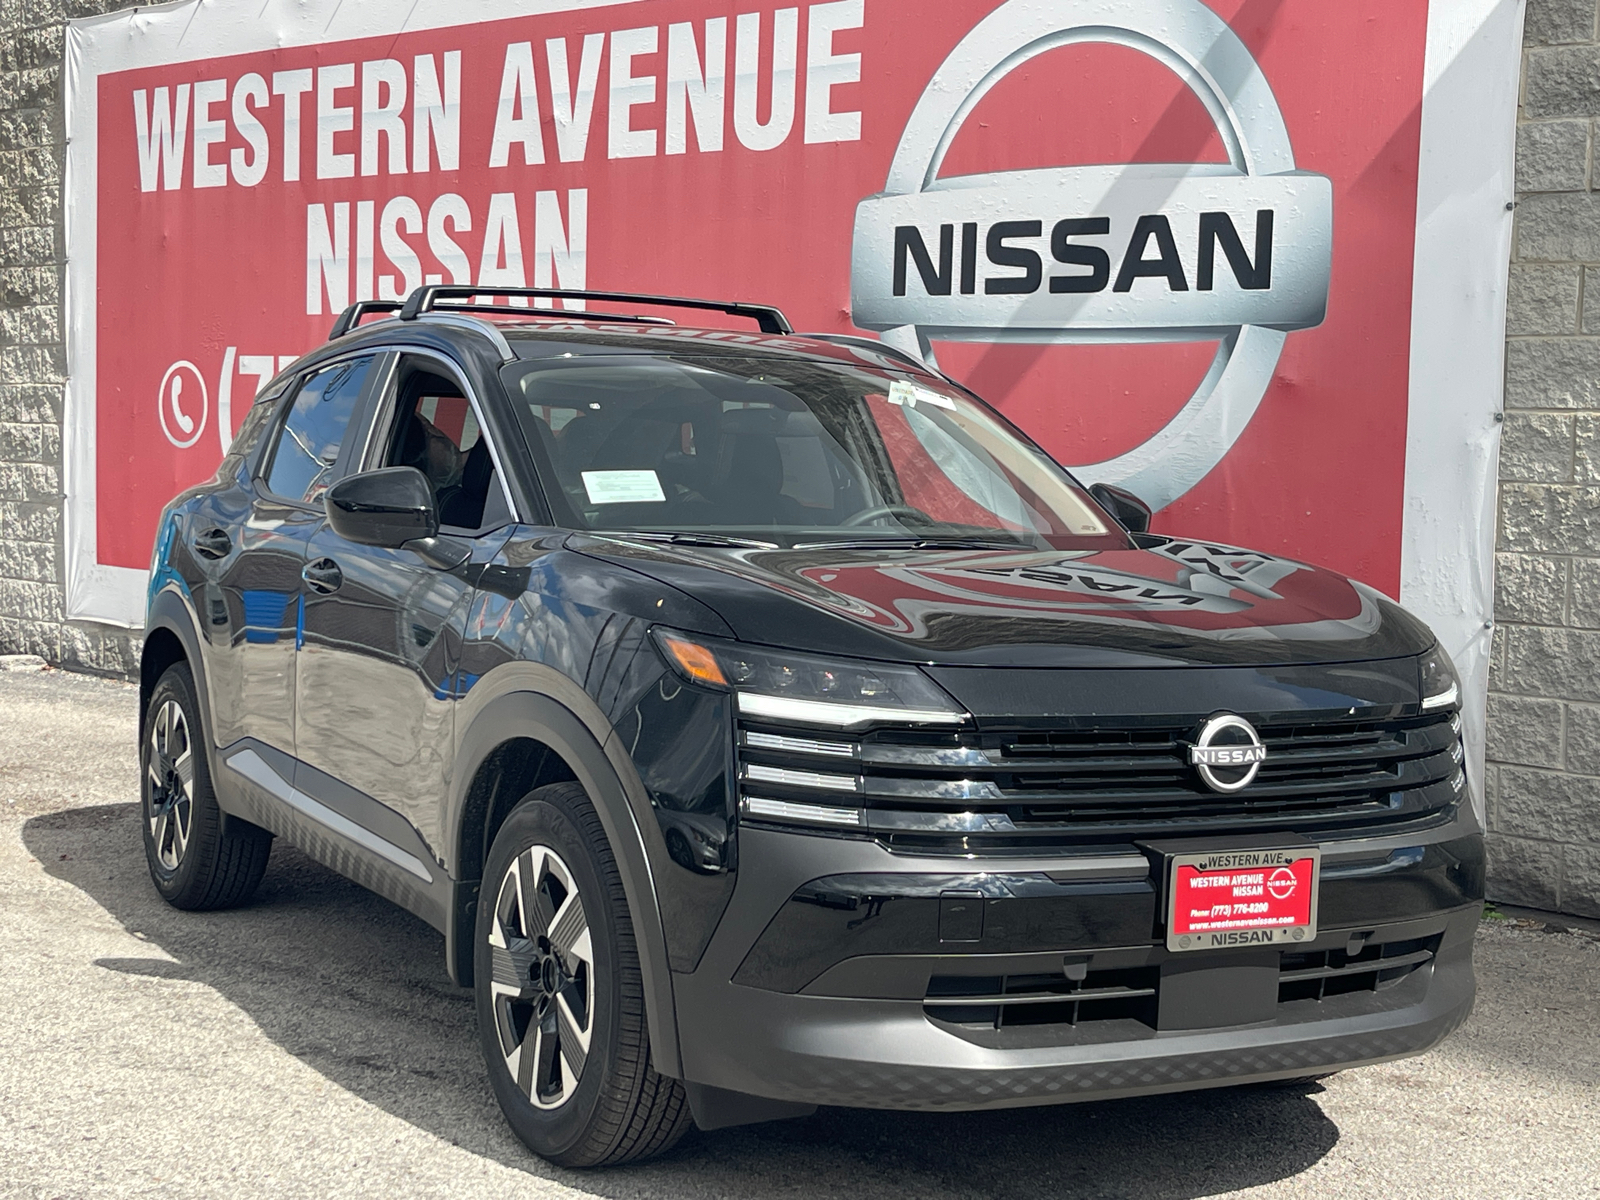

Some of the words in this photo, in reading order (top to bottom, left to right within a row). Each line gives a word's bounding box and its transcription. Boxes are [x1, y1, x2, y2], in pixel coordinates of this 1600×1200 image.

[133, 51, 462, 192] WESTERN
[489, 0, 864, 169] AVENUE
[306, 188, 588, 315] NISSAN
[892, 209, 1274, 297] NISSAN
[1194, 747, 1266, 763] NISSAN
[1208, 854, 1260, 867] WESTERN
[1190, 876, 1230, 888] WESTERN
[1231, 874, 1264, 886] AVENUE
[1267, 879, 1297, 887] NISSAN
[1233, 885, 1263, 897] NISSAN
[1211, 905, 1231, 918] (773)
[1233, 902, 1269, 914] 776-8200
[1211, 930, 1273, 946] NISSAN
